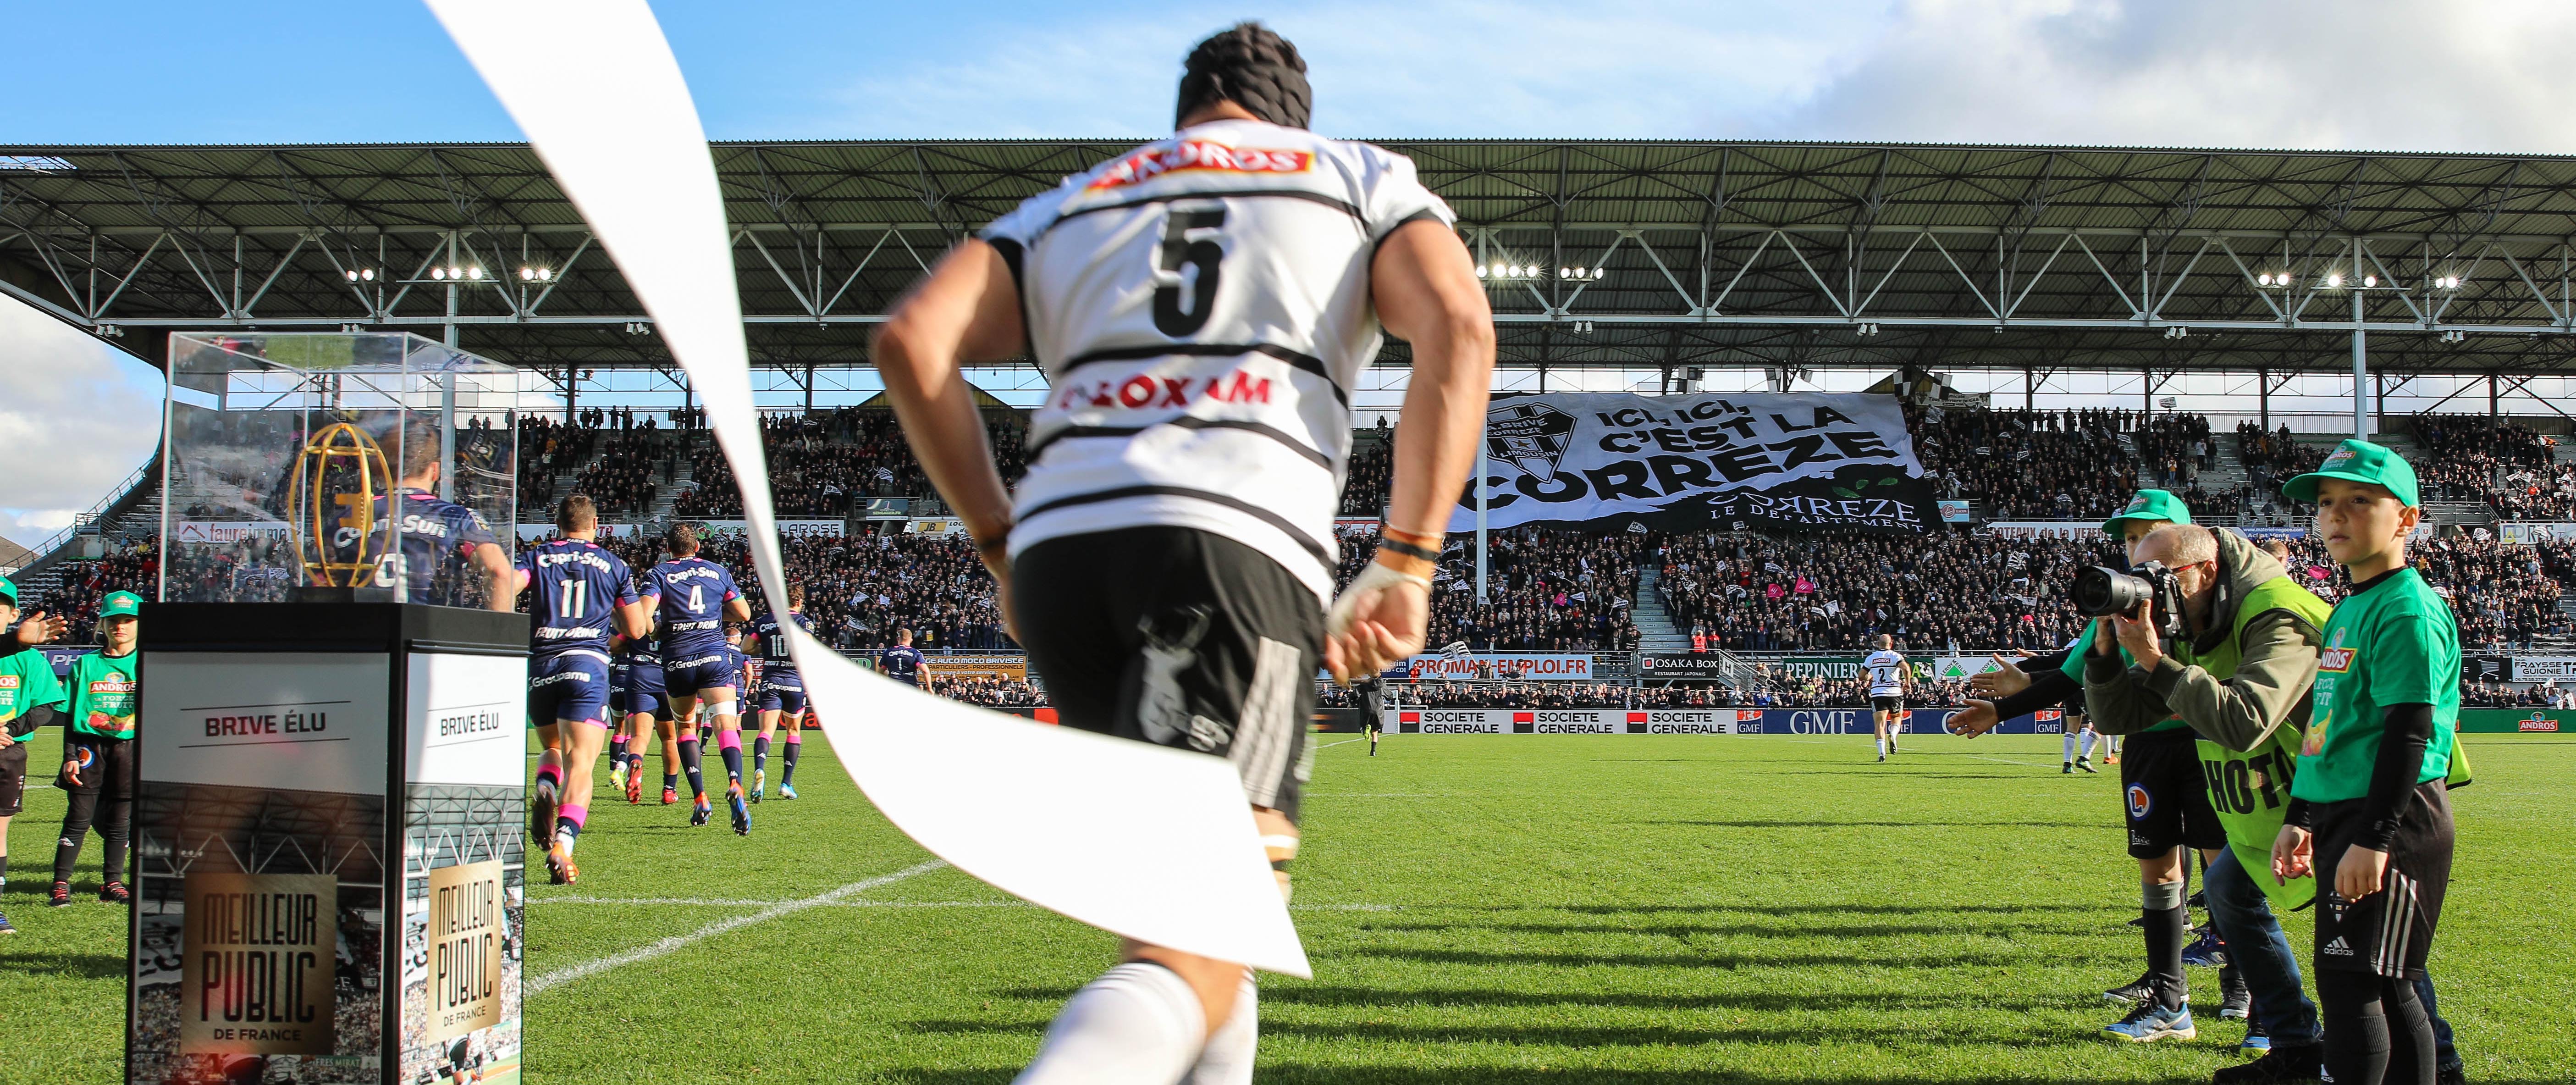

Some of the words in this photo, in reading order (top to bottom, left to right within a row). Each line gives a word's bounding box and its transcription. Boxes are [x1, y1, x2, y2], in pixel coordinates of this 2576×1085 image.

[1154, 200, 1225, 337] 5
[1596, 407, 1671, 427] ICI,
[1674, 399, 1750, 424] ICI,
[1487, 418, 1548, 431] A.BRIVE
[1599, 416, 1758, 454] C'EST
[1770, 406, 1858, 433] LA
[1710, 506, 1735, 519] LE
[924, 523, 936, 531] JB
[2074, 527, 2107, 538] VEZER
[538, 551, 612, 574] Capri-Sun
[667, 567, 720, 583] Capri-Sun
[561, 579, 586, 619] 11
[689, 585, 706, 614] 4
[770, 635, 789, 656] 10
[676, 655, 722, 669] Groupama
[897, 658, 902, 670] 1
[1655, 659, 1693, 668] OSAKA
[1940, 662, 1954, 676] LEROY
[1952, 659, 1968, 676] MERLIN
[1989, 659, 2000, 671] MERL
[1785, 663, 1864, 678] PEPINIER
[1878, 668, 1886, 682] 2
[532, 671, 591, 686] Groupama
[91, 682, 136, 691] ANDROS
[205, 715, 277, 737] BRIVE
[285, 709, 326, 733] ÉLU
[441, 715, 476, 736] BRIVE
[480, 709, 499, 731] ÉLU
[1424, 712, 1485, 722] SOCIETE
[1539, 712, 1599, 722] SOCIETE
[1652, 712, 1712, 722] SOCIETE
[1789, 710, 1856, 734] GMF
[1424, 724, 1499, 734] GENERALE
[1539, 724, 1613, 734] GENERALE
[1652, 724, 1727, 734] GENERALE
[1738, 724, 1760, 733] GMF
[2037, 724, 2059, 733] GMF
[2520, 721, 2555, 730] ANDROS
[2201, 745, 2296, 815] HOTO
[438, 879, 494, 937] MEILLEUR
[203, 892, 317, 945] MEILLEUR
[2324, 947, 2354, 956] adidas
[437, 932, 493, 1012] PUBLIC
[201, 951, 315, 1023] PUBLIC
[443, 1016, 454, 1027] DE
[456, 1005, 486, 1023] FRANCE
[214, 1029, 235, 1041] DE
[239, 1029, 302, 1041] FRANCE
